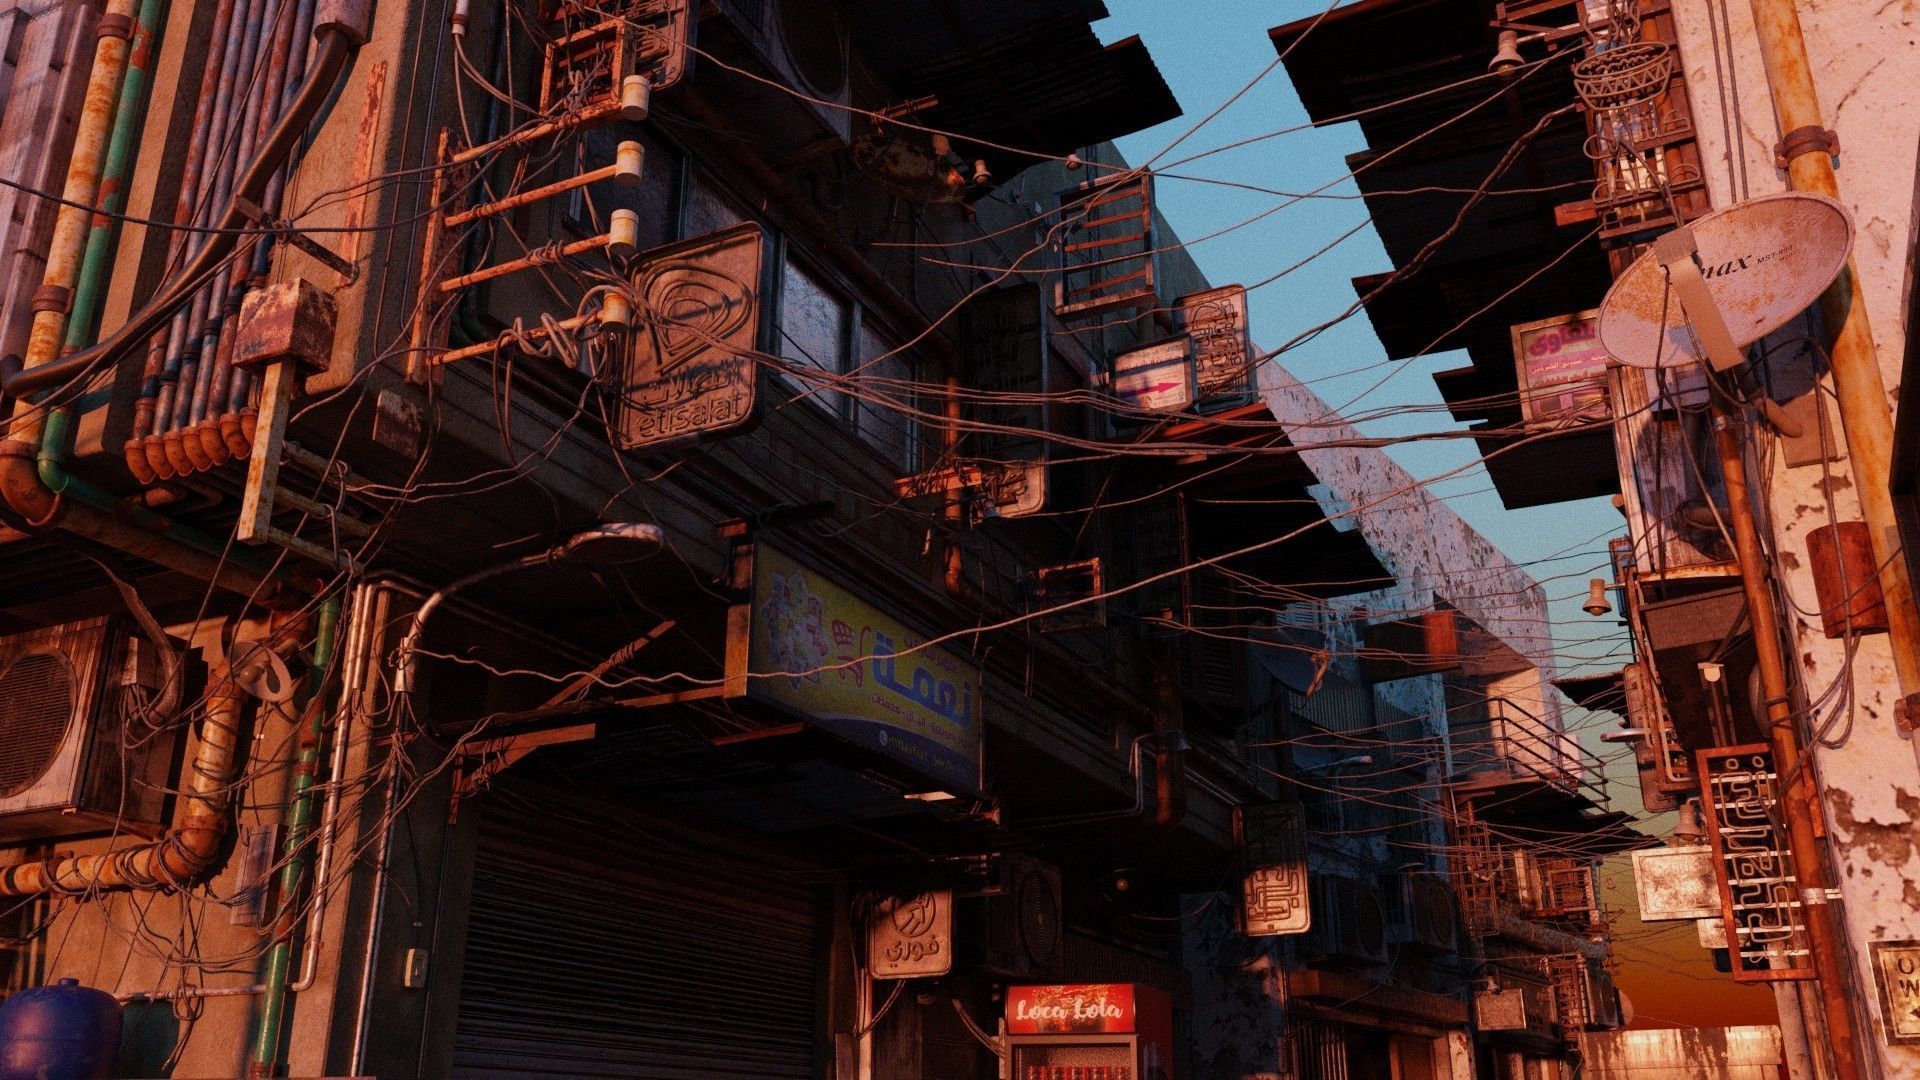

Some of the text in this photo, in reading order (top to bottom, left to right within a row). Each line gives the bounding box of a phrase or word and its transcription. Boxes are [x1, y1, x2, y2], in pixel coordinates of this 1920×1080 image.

[639, 393, 742, 438] etisalat
[873, 631, 972, 728] نعمة
[1016, 999, 1068, 1021] Loca
